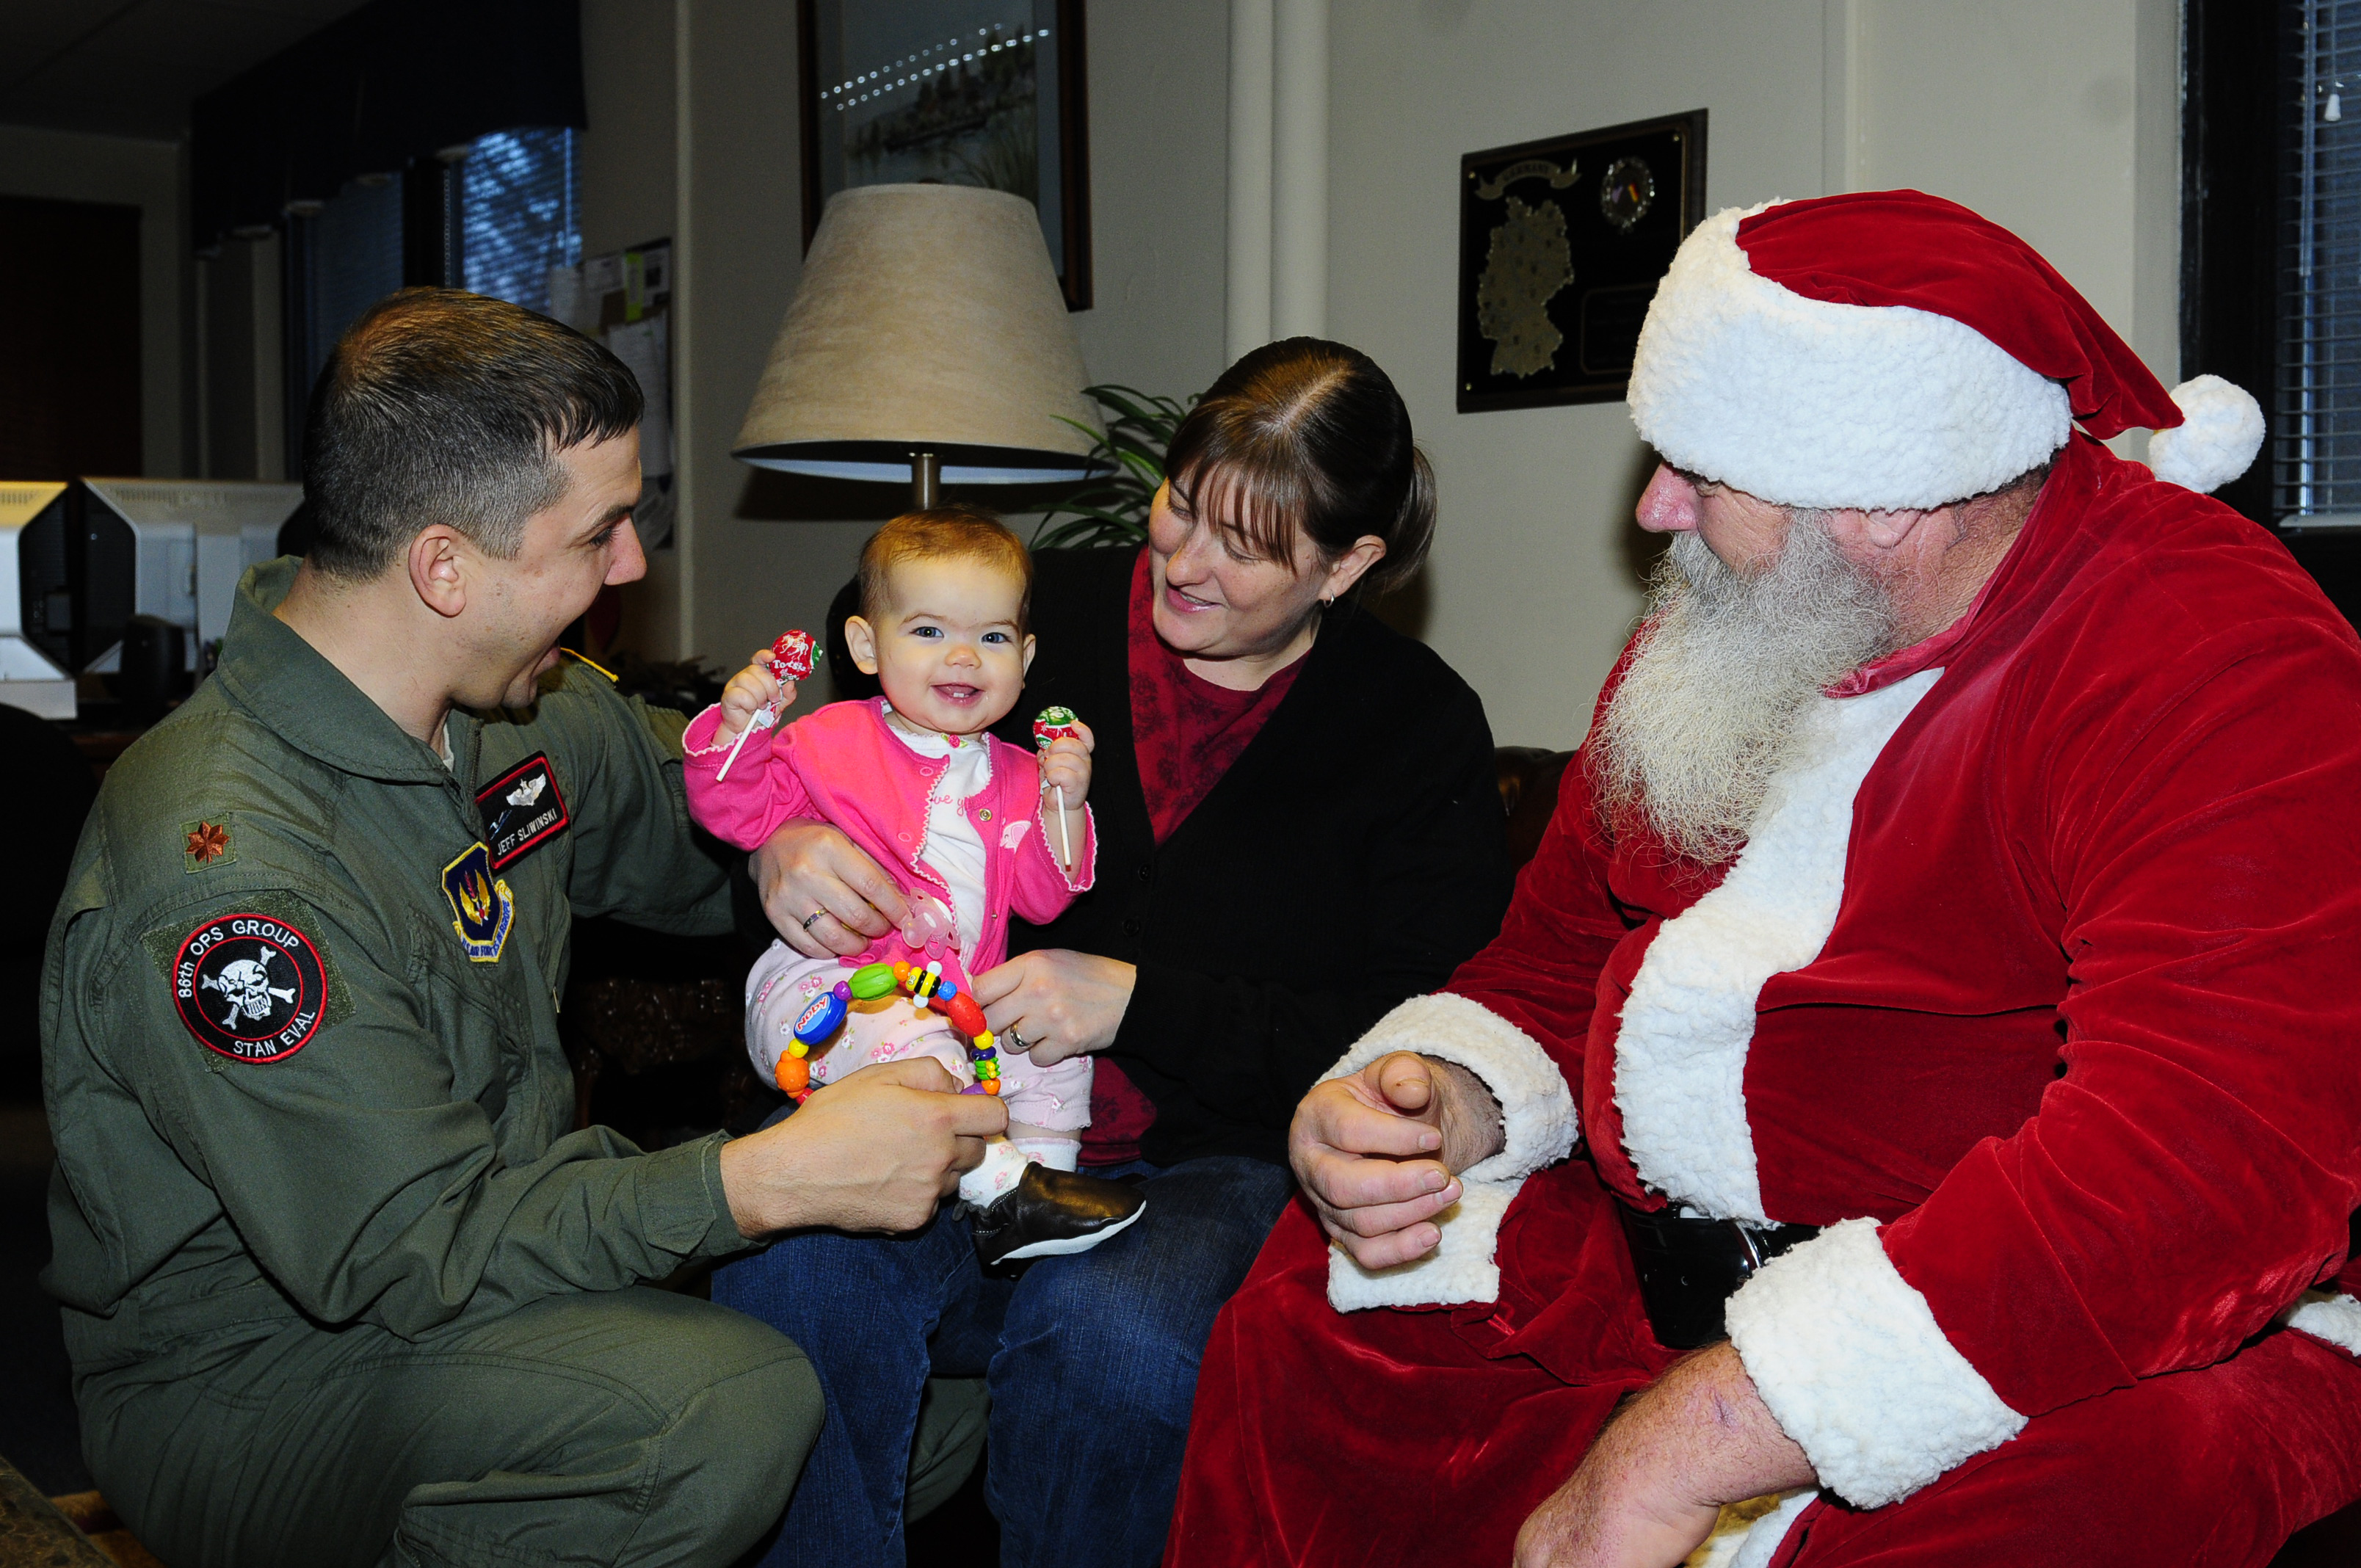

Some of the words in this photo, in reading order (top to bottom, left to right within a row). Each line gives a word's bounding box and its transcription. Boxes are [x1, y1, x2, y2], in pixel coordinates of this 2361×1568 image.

[498, 833, 515, 856] JEFF
[517, 807, 558, 841] SLIWINSKI
[178, 961, 195, 998] 86th
[190, 926, 224, 956] OPS
[232, 920, 300, 948] GROUP
[233, 1039, 277, 1057] STAN
[280, 1011, 316, 1046] EVAL
